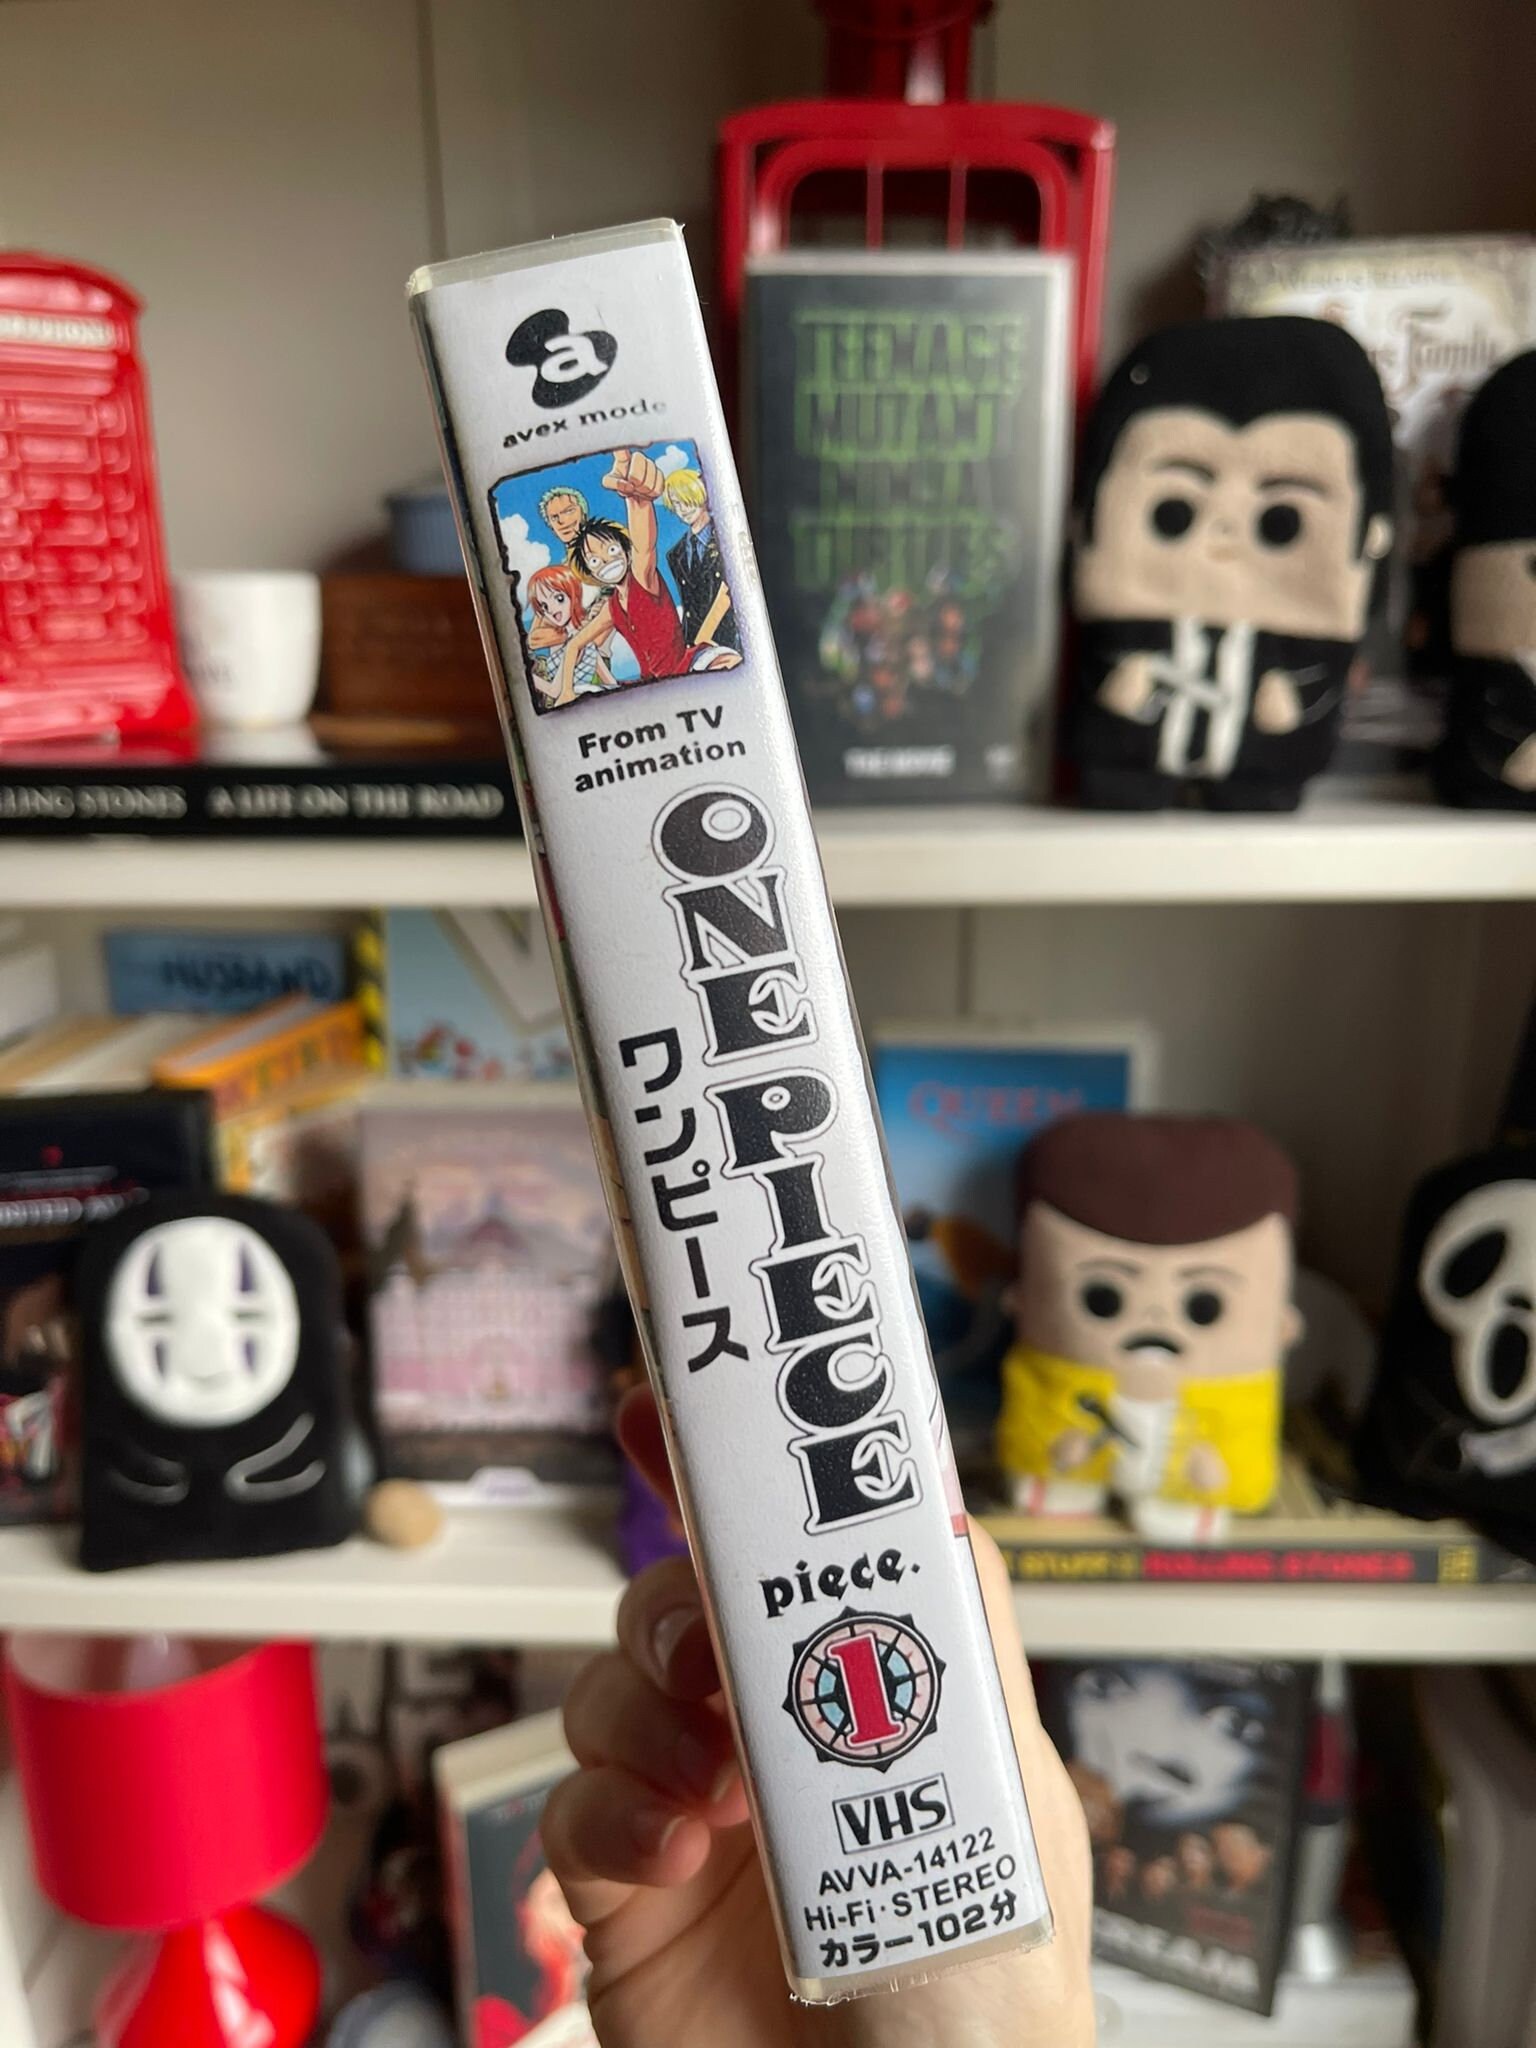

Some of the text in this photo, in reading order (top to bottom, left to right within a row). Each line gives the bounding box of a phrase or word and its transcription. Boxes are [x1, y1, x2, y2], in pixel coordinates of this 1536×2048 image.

[502, 398, 668, 450] avex mode
[577, 706, 724, 758] From TV
[573, 737, 747, 793] animation
[76, 785, 188, 818] STONES
[297, 784, 348, 817] ON
[351, 784, 411, 817] THE
[413, 784, 503, 818] ROAD
[651, 782, 923, 1536] ONE PIECE
[619, 1027, 749, 1373] ワンピース
[759, 1548, 920, 1618] piece.
[1144, 1549, 1276, 1579] ROLLING
[1282, 1549, 1415, 1579] STONES
[825, 1630, 905, 1749] 1
[839, 1779, 946, 1846] VHS
[818, 1827, 996, 1896] AVVA-14122
